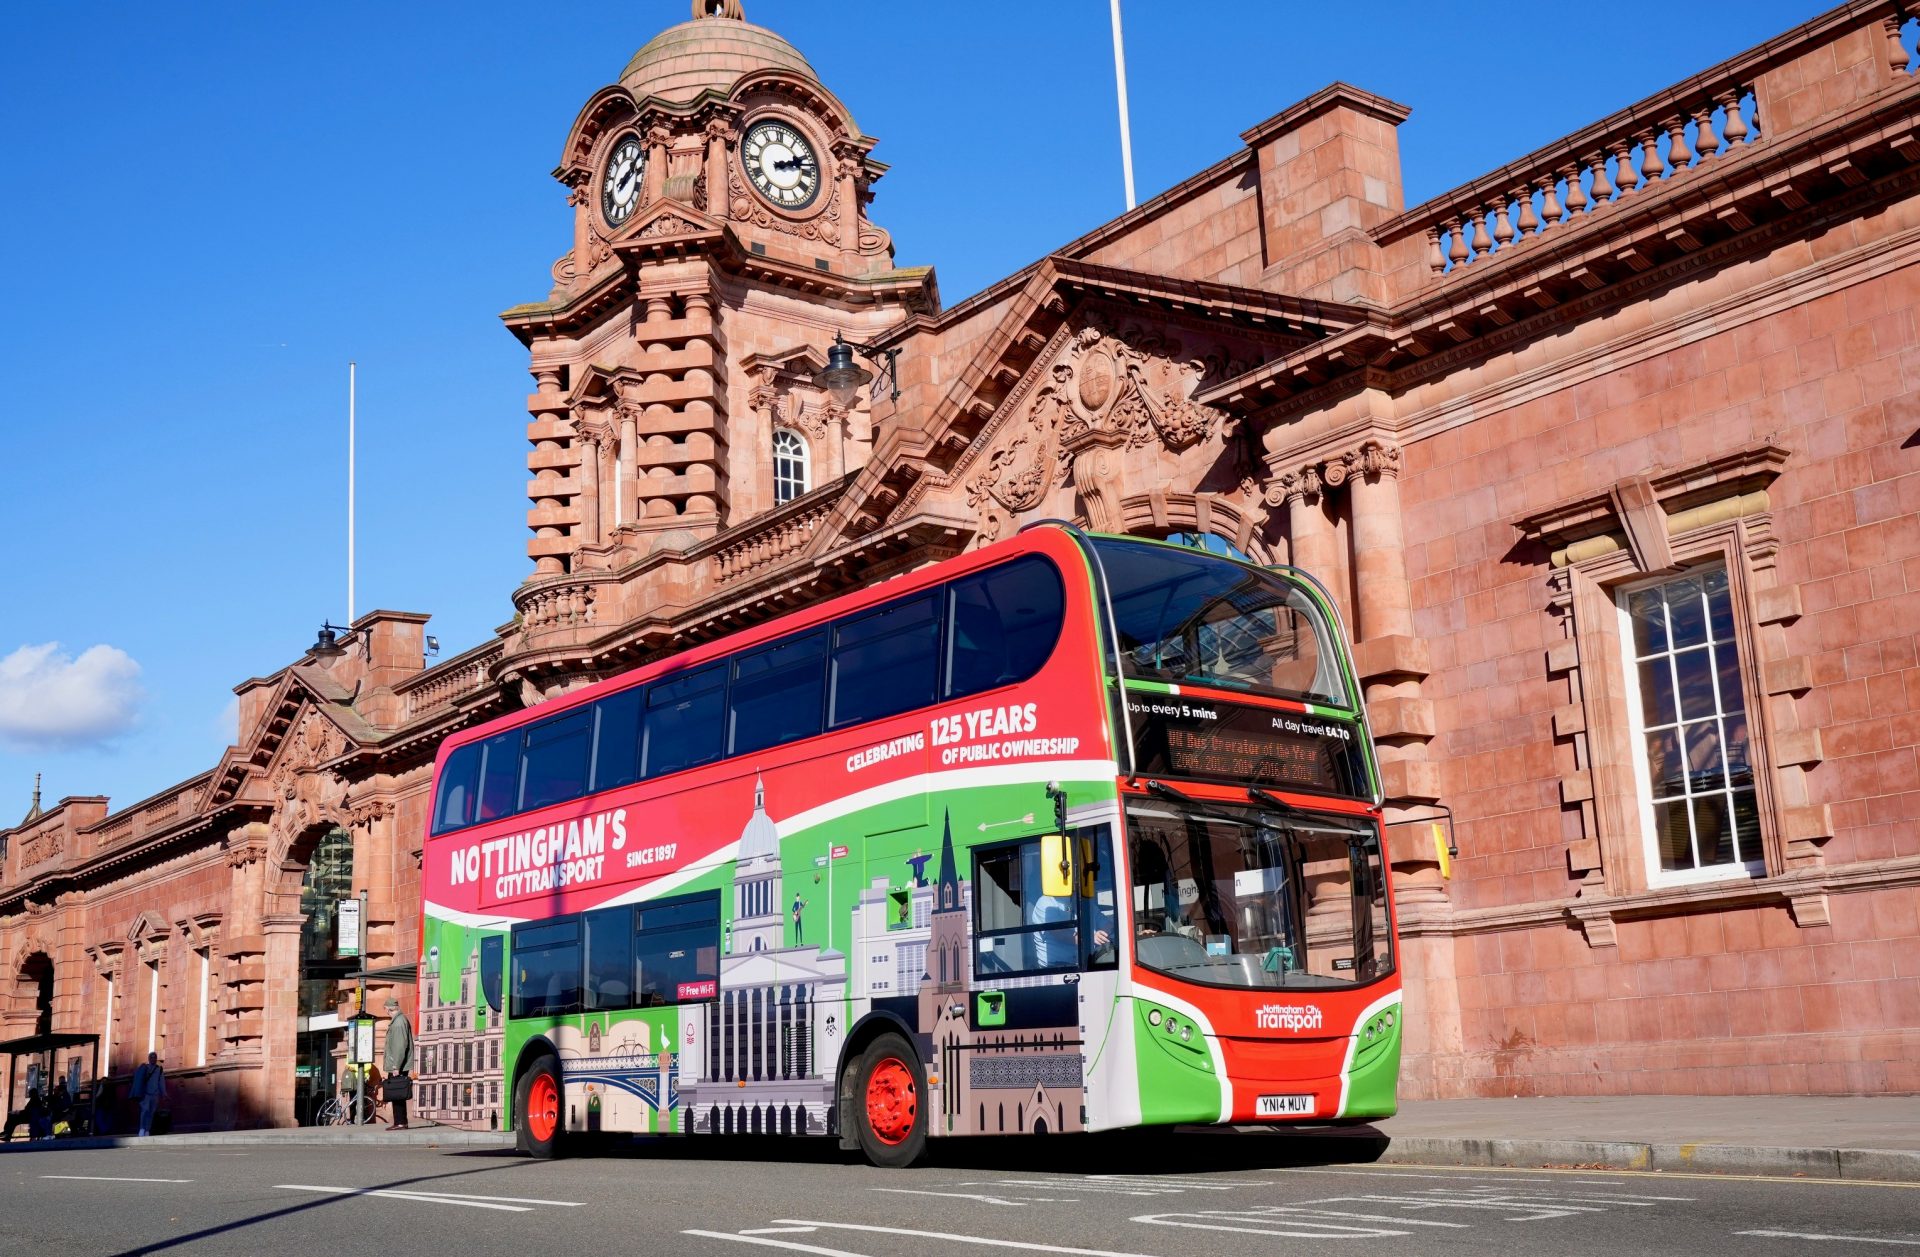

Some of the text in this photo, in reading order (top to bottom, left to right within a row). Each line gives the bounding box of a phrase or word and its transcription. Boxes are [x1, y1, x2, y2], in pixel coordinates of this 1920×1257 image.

[1128, 703, 1218, 720] Up to every 5 mins
[930, 702, 1037, 747] 125 YEARS
[1272, 717, 1350, 741] All day travel £4.70
[846, 732, 924, 773] CELEBRATING
[941, 737, 1080, 765] OF PUBLIC OWNERSHIP
[451, 809, 627, 885] NOTTINGHAM'S
[626, 843, 677, 868] SINCE 1897
[686, 984, 714, 996] Free Wi-Fi
[1256, 1009, 1322, 1032] Transport
[1263, 1004, 1319, 1015] Nottingham City
[1263, 1097, 1307, 1112] YN14 MUV
